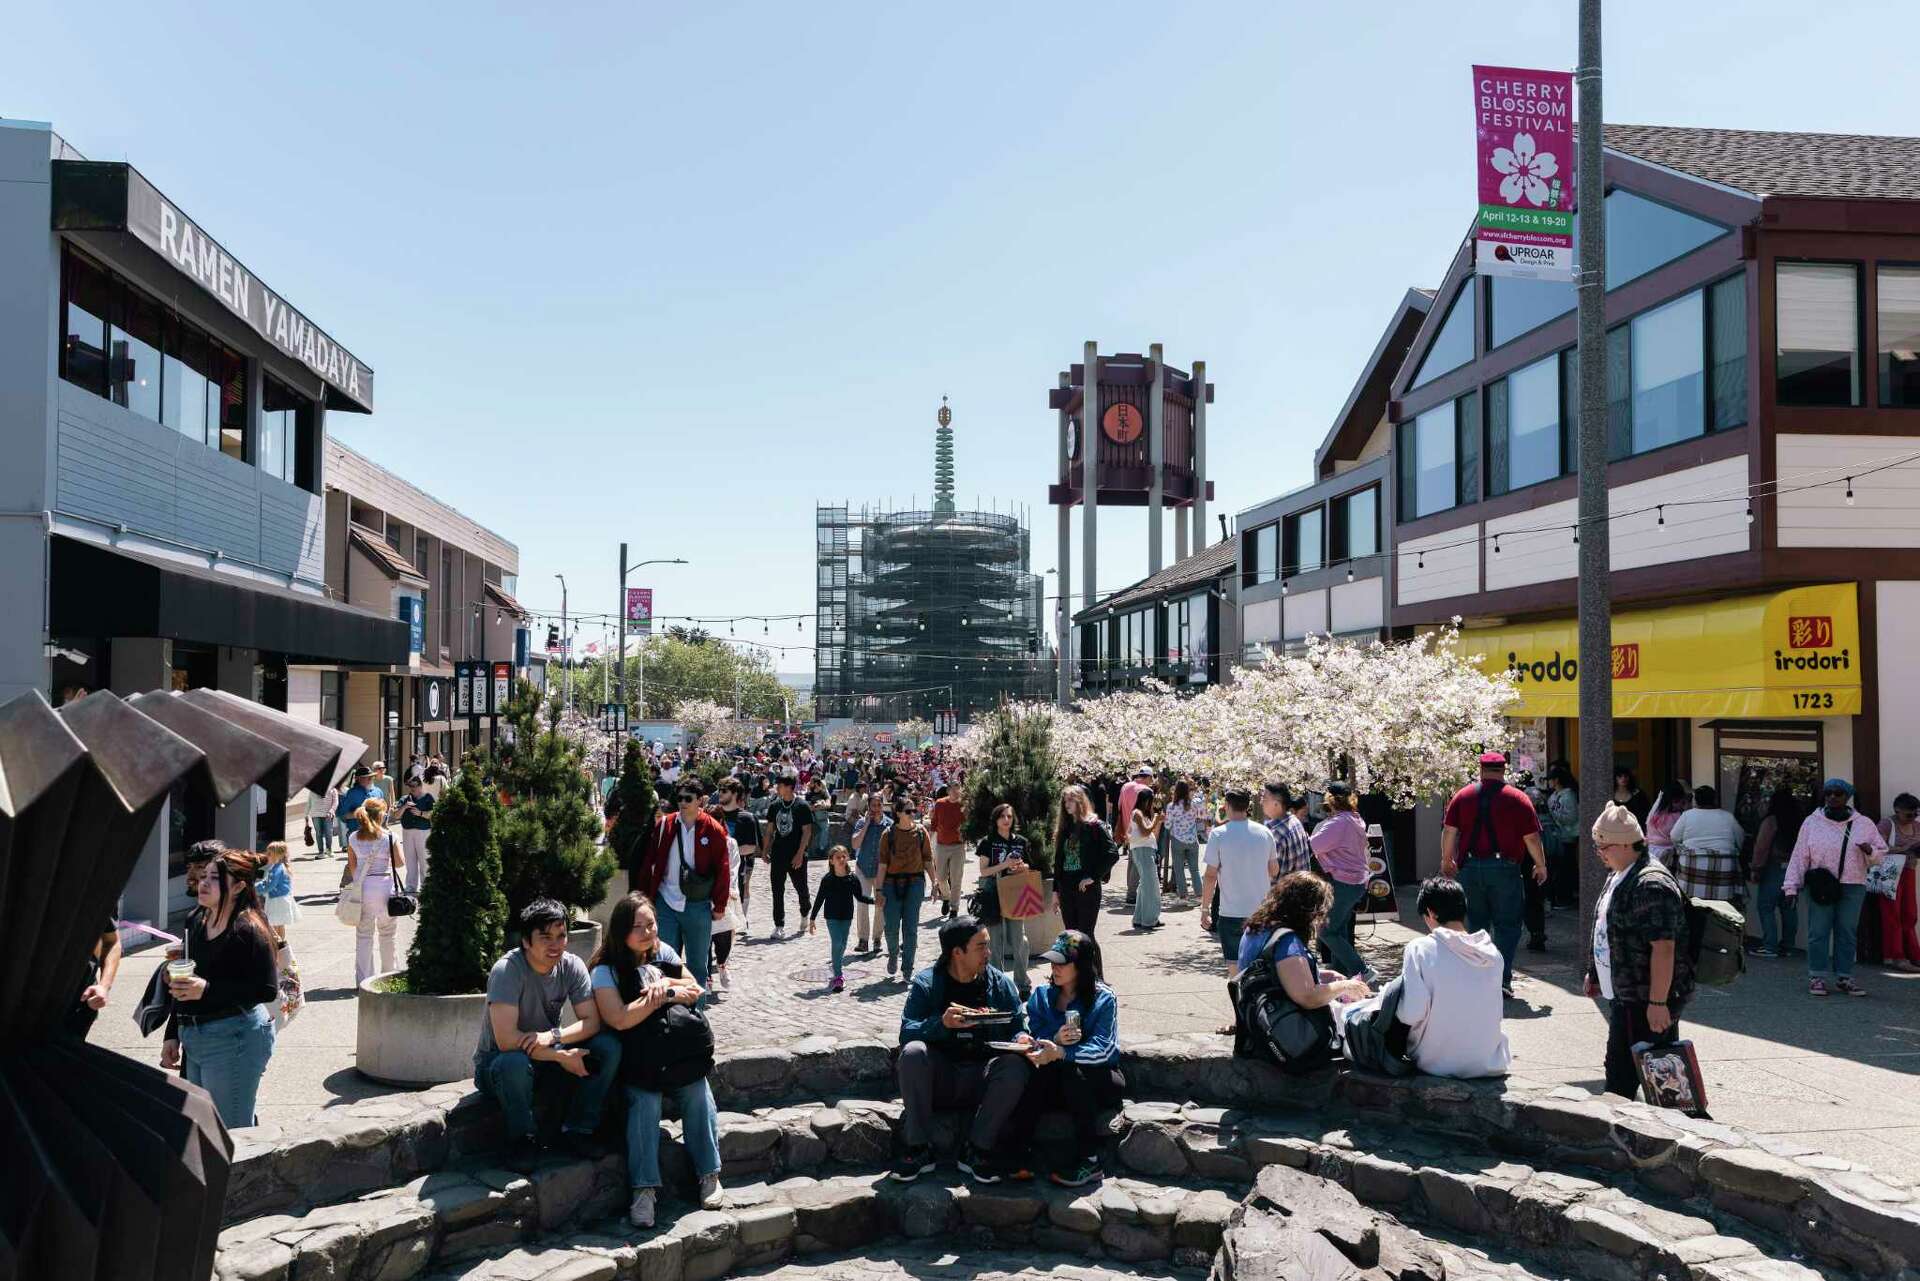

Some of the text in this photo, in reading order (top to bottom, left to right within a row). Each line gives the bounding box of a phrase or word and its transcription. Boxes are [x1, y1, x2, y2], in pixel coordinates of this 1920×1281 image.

[1480, 79, 1566, 100] CHERRY
[1481, 96, 1566, 117] BLOSSOM
[1482, 113, 1566, 133] FESTIVAL
[1482, 210, 1566, 226] April 12-13 & 19-20
[1510, 246, 1554, 260] UPROAR
[160, 201, 361, 398] RAMEN YAMADAYA
[1792, 618, 1831, 647] 彩り
[1508, 651, 1578, 682] irodo
[1774, 649, 1850, 670] irodori
[1793, 693, 1834, 709] 1723
